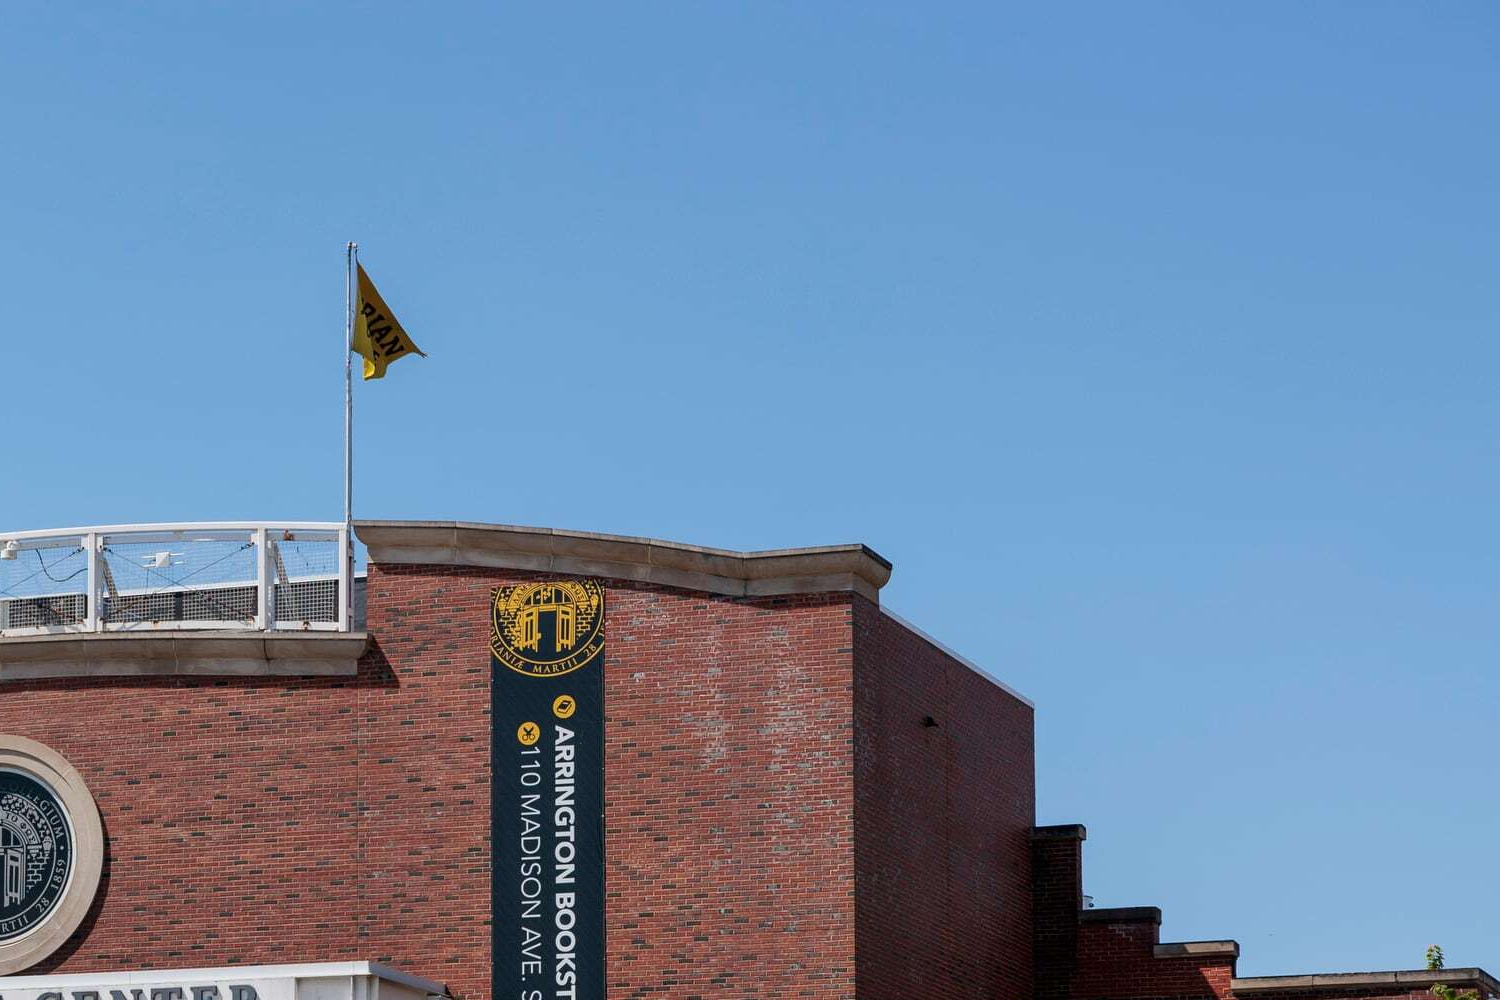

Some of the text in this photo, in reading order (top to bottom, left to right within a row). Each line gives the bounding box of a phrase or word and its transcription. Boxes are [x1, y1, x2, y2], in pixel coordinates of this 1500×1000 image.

[532, 656, 577, 673] MARTII
[583, 644, 597, 657] 28
[520, 746, 541, 787] 110
[555, 724, 576, 884] ARRINGTON
[520, 794, 542, 919] MADISON
[35, 897, 50, 914] 28
[50, 858, 66, 891] 1859
[521, 926, 542, 982] AVE.
